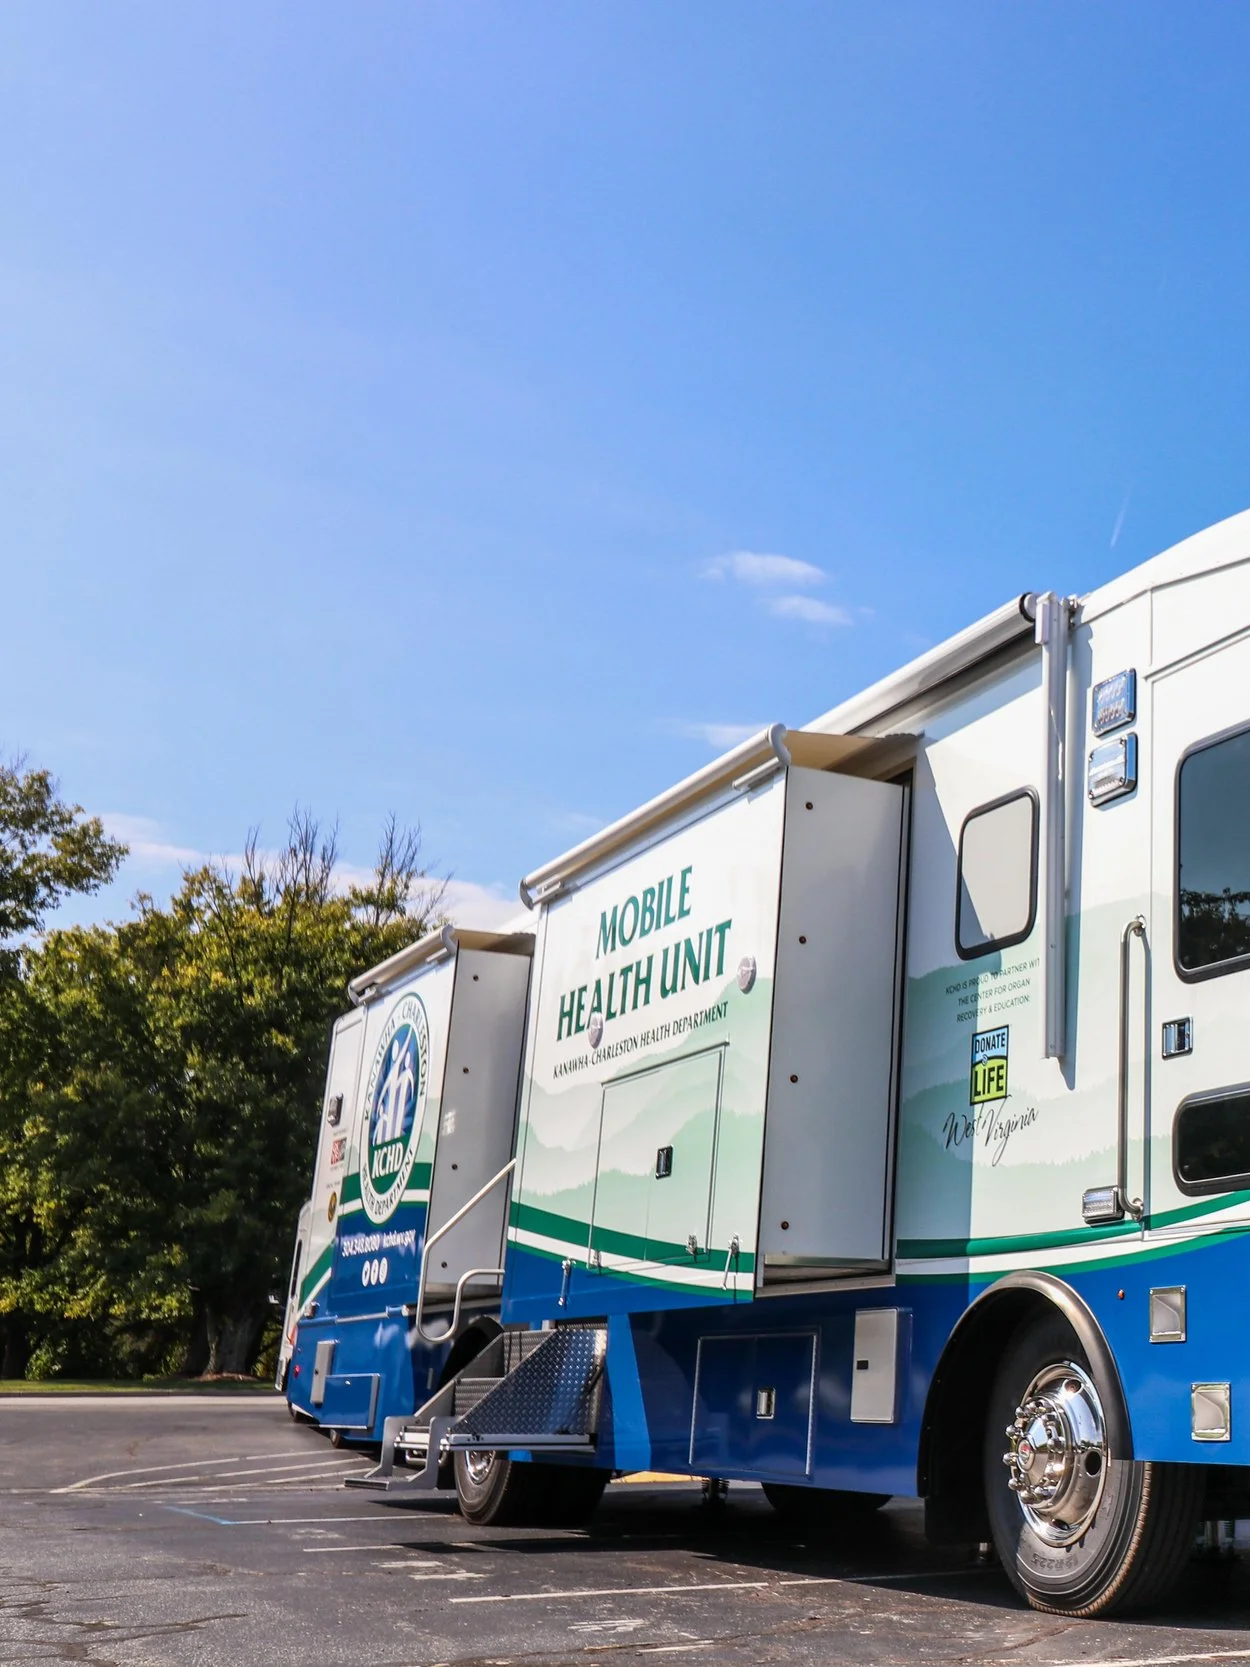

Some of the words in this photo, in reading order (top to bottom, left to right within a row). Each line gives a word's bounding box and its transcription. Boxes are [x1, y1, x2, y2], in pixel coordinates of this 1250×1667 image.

[596, 865, 692, 960] MOBILE
[556, 953, 654, 1042] HEALTH
[659, 918, 733, 999] UNIT
[958, 995, 969, 1006] THE
[969, 989, 993, 1002] CENTER
[994, 985, 1007, 996] FOR
[1008, 978, 1031, 991] ORGAN
[968, 974, 988, 986] PROUD
[990, 971, 999, 980] TO
[999, 962, 1028, 977] PARTNER
[1029, 957, 1040, 968] WIT
[553, 1035, 638, 1079] KANAWHA-CHARLESTON
[640, 1023, 671, 1047] HEALTH
[672, 1001, 728, 1035] DEPARTMENT
[956, 1008, 988, 1023] RECOVERY
[402, 1001, 427, 1097] CHARLESTON
[975, 1032, 1006, 1054] DONATE
[973, 1063, 1005, 1097] LIFE
[942, 1102, 985, 1149] West
[981, 1094, 1040, 1167] Virginia
[371, 1142, 404, 1180] KCHD
[374, 1148, 413, 1216] DEPARTMENT
